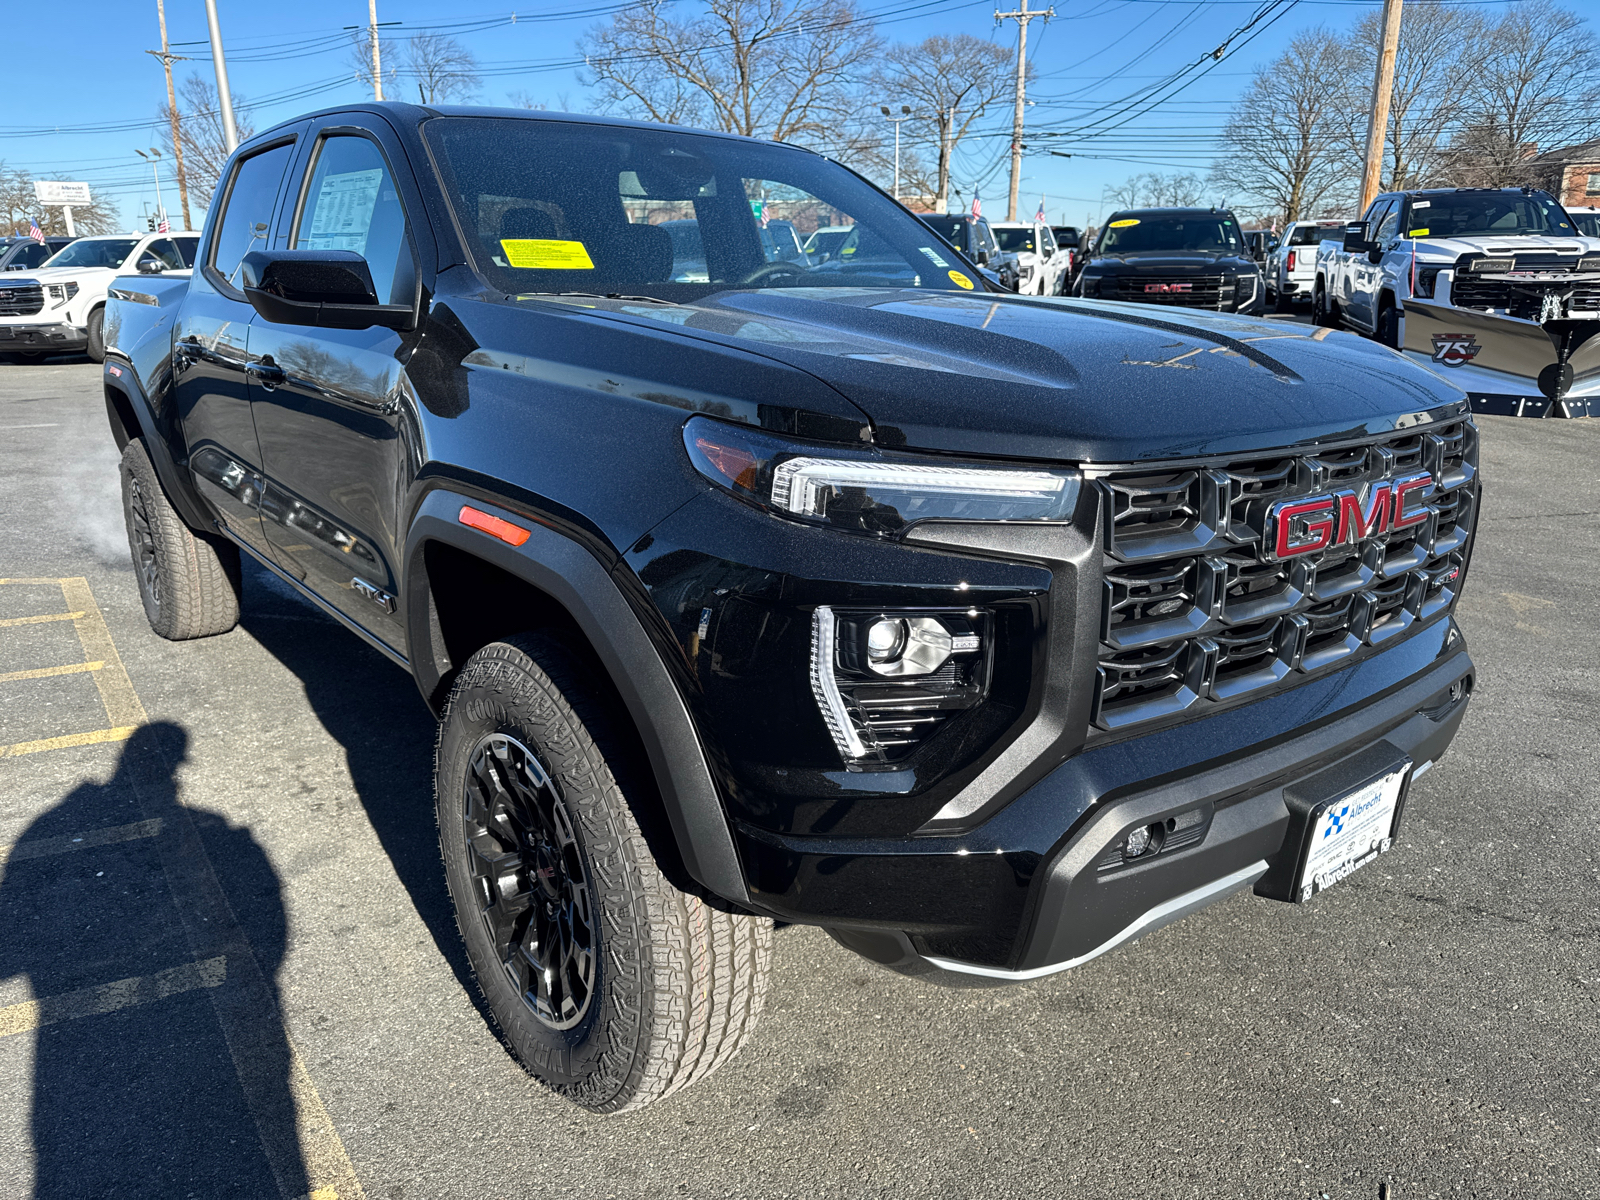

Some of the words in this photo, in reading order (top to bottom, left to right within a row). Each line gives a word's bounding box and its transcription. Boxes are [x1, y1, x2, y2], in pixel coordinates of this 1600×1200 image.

[1144, 283, 1192, 293] GMC
[1436, 342, 1470, 364] 75
[1270, 475, 1433, 559] GMC
[350, 577, 397, 614] AT4
[1348, 791, 1382, 820] Albrecht
[1319, 858, 1356, 891] Albrecht
